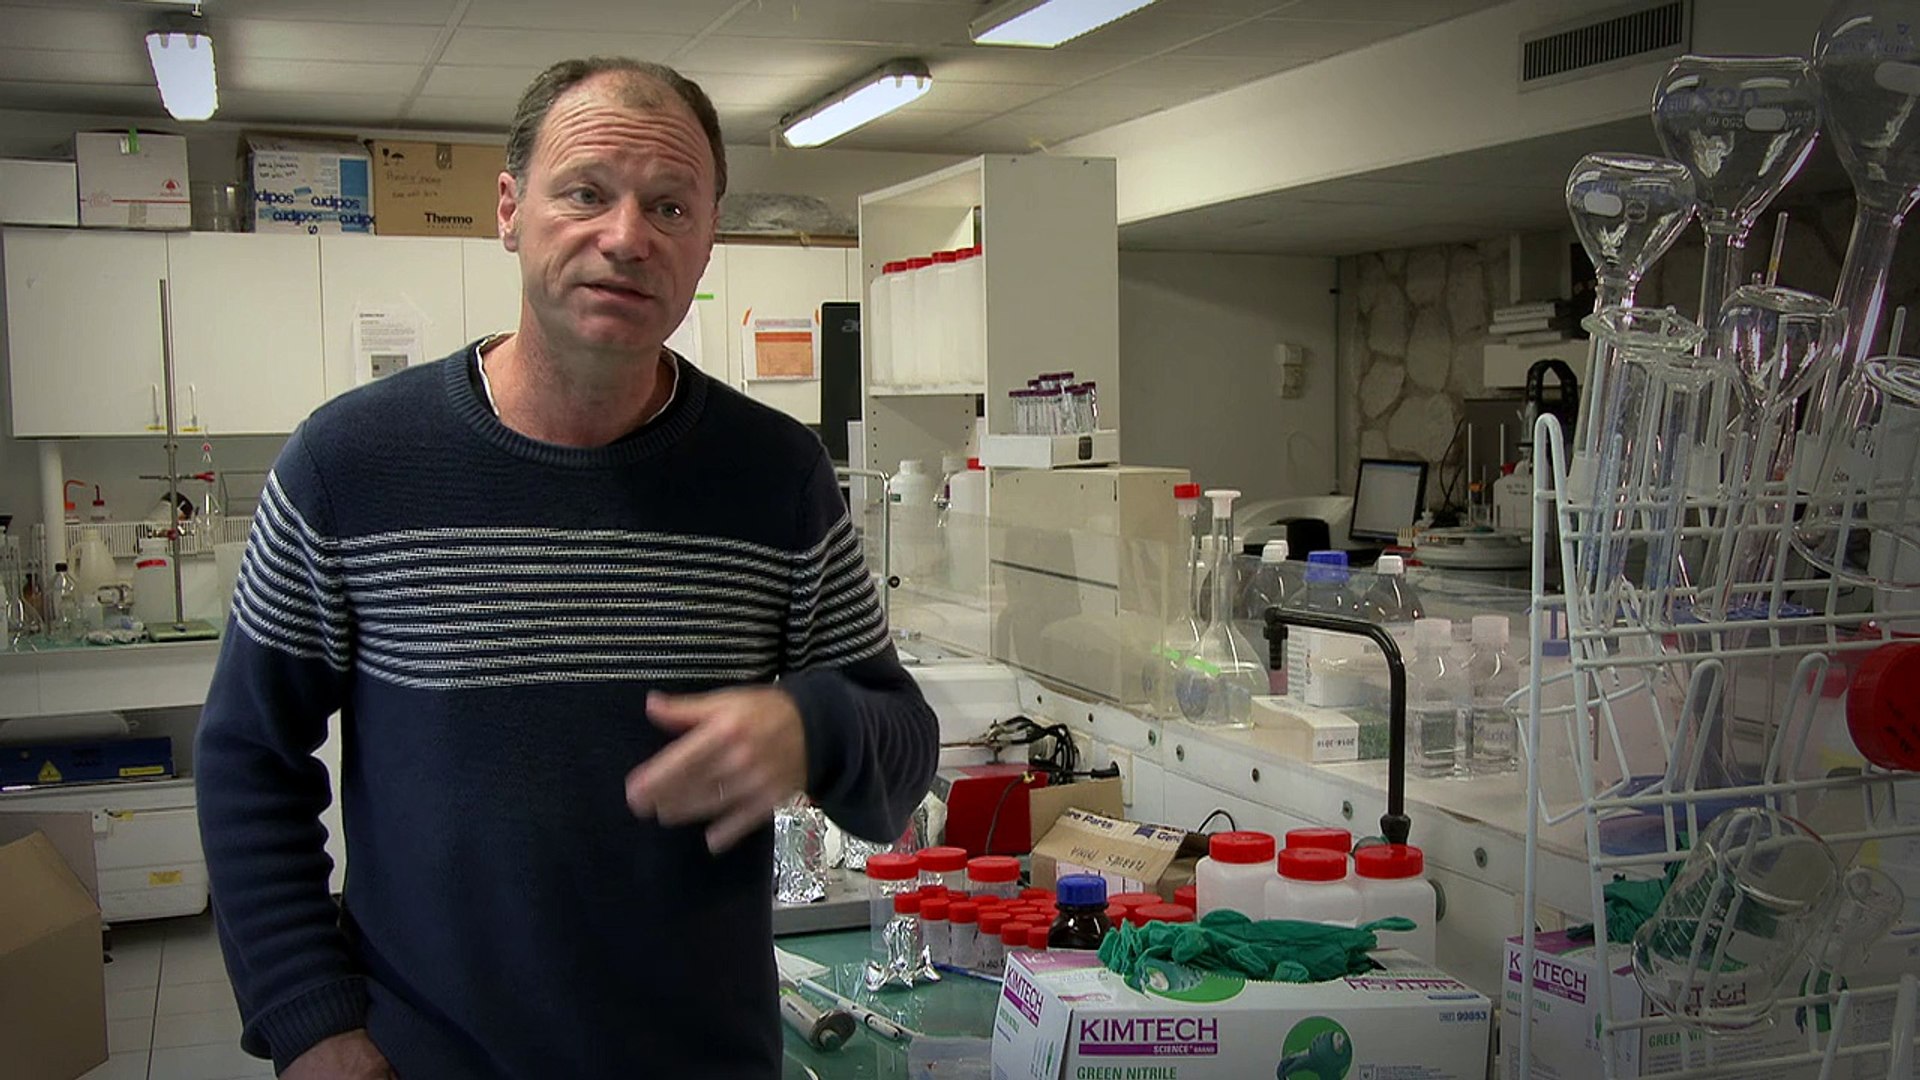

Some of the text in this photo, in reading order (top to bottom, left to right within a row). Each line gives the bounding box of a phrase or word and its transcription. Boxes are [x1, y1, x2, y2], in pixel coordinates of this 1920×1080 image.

[424, 211, 473, 224] Thermo
[1083, 815, 1113, 829] Parts
[1080, 1018, 1217, 1041] KIMTECH
[1153, 1045, 1188, 1053] SCIENCE
[1077, 1066, 1177, 1080] GREEN NITRILE
